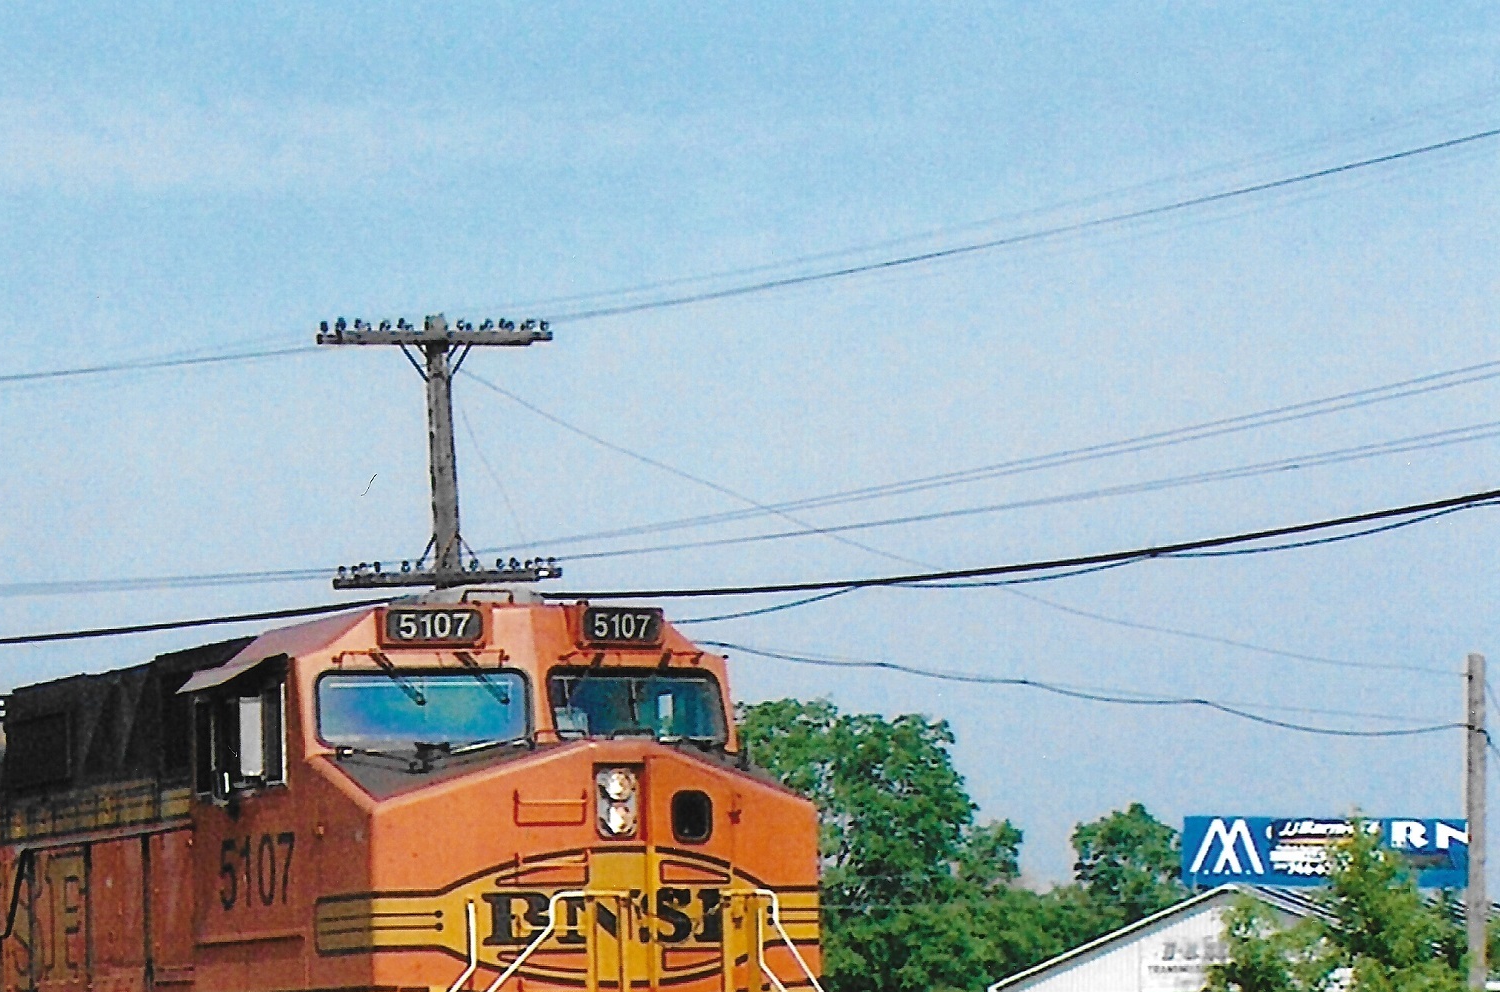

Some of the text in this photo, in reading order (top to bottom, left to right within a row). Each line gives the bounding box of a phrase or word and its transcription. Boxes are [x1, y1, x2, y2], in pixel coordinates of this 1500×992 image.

[399, 612, 471, 639] 5107
[594, 612, 650, 639] 5107
[219, 831, 295, 911] 5107
